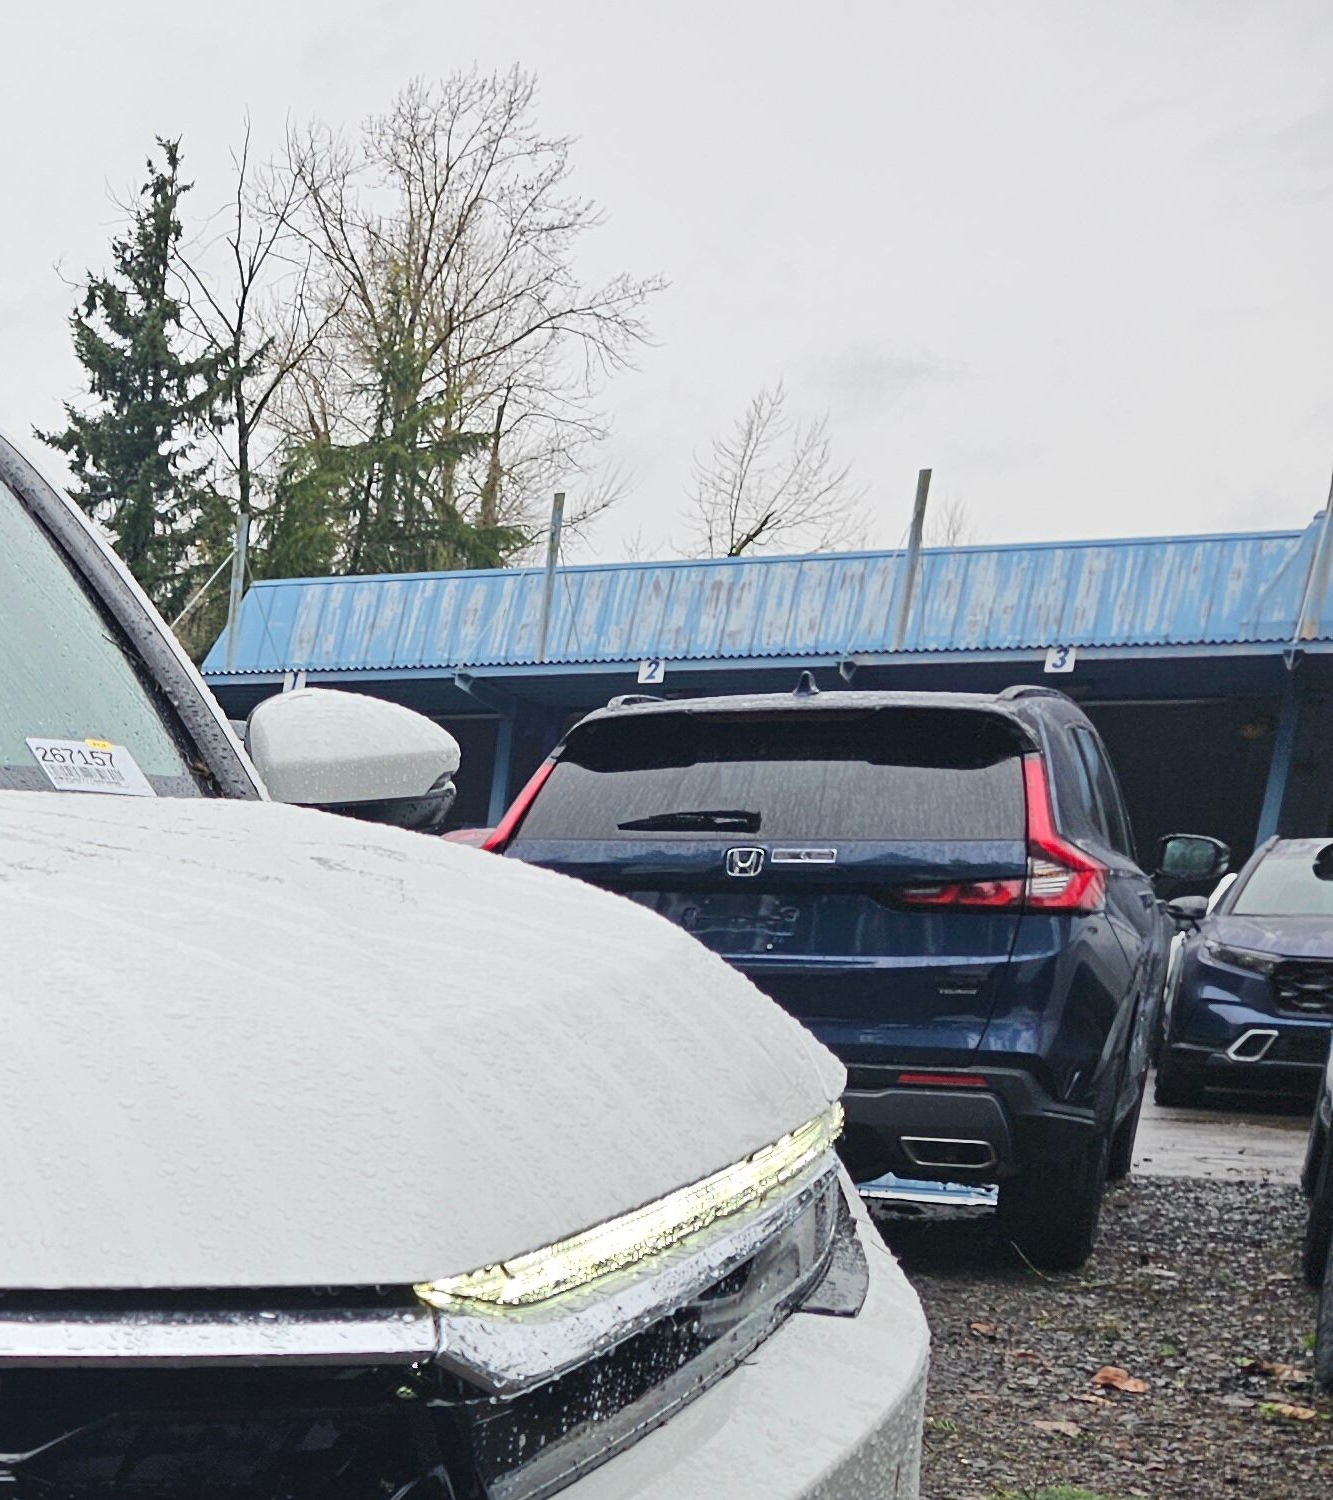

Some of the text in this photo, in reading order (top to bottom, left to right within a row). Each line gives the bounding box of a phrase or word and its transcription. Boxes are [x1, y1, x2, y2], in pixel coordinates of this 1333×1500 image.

[1051, 647, 1070, 669] 3
[644, 660, 660, 680] 2
[35, 746, 115, 768] 267157
